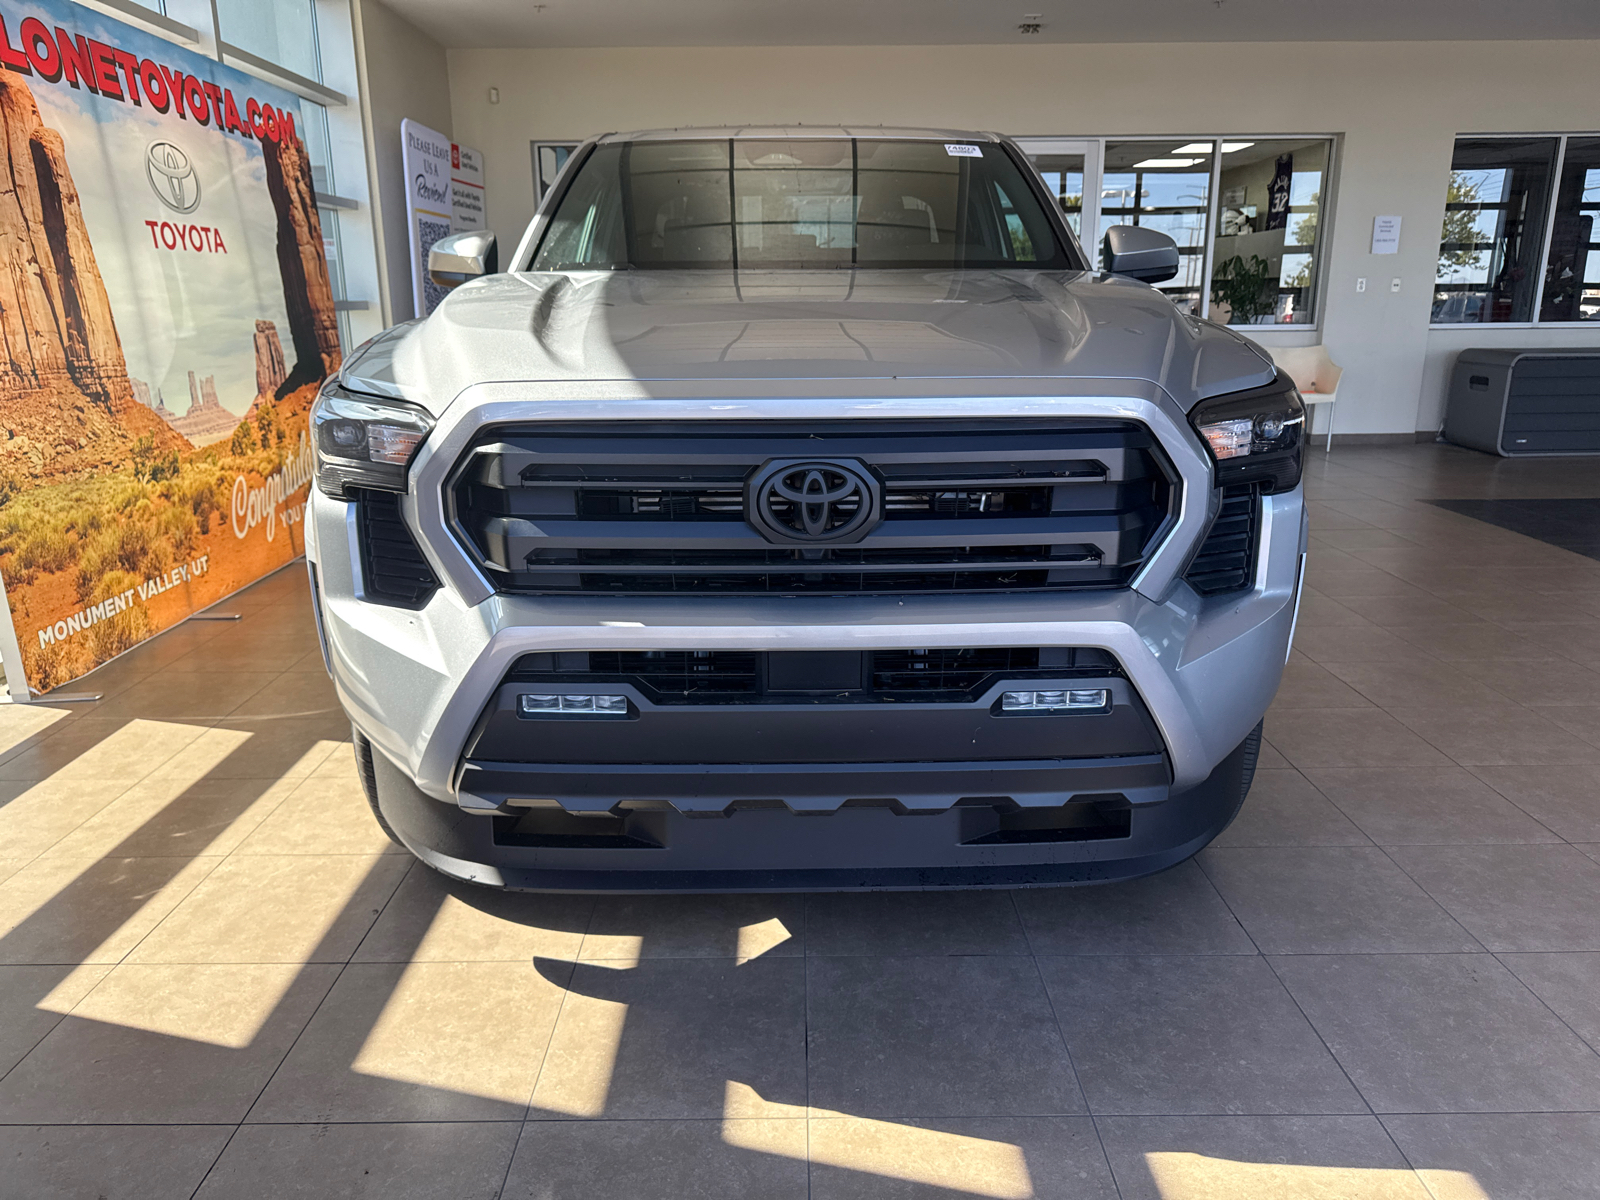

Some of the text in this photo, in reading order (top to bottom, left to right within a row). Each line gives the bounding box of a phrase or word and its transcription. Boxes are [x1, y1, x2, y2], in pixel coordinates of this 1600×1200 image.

[408, 132, 449, 162] PLEASE LEAVE
[423, 159, 439, 177] US A
[415, 173, 448, 204] Review!
[1271, 192, 1289, 213] 32
[145, 220, 227, 254] TOYOTA
[279, 505, 301, 527] YOU
[38, 555, 209, 650] MONUMENT VALLEY, UT
